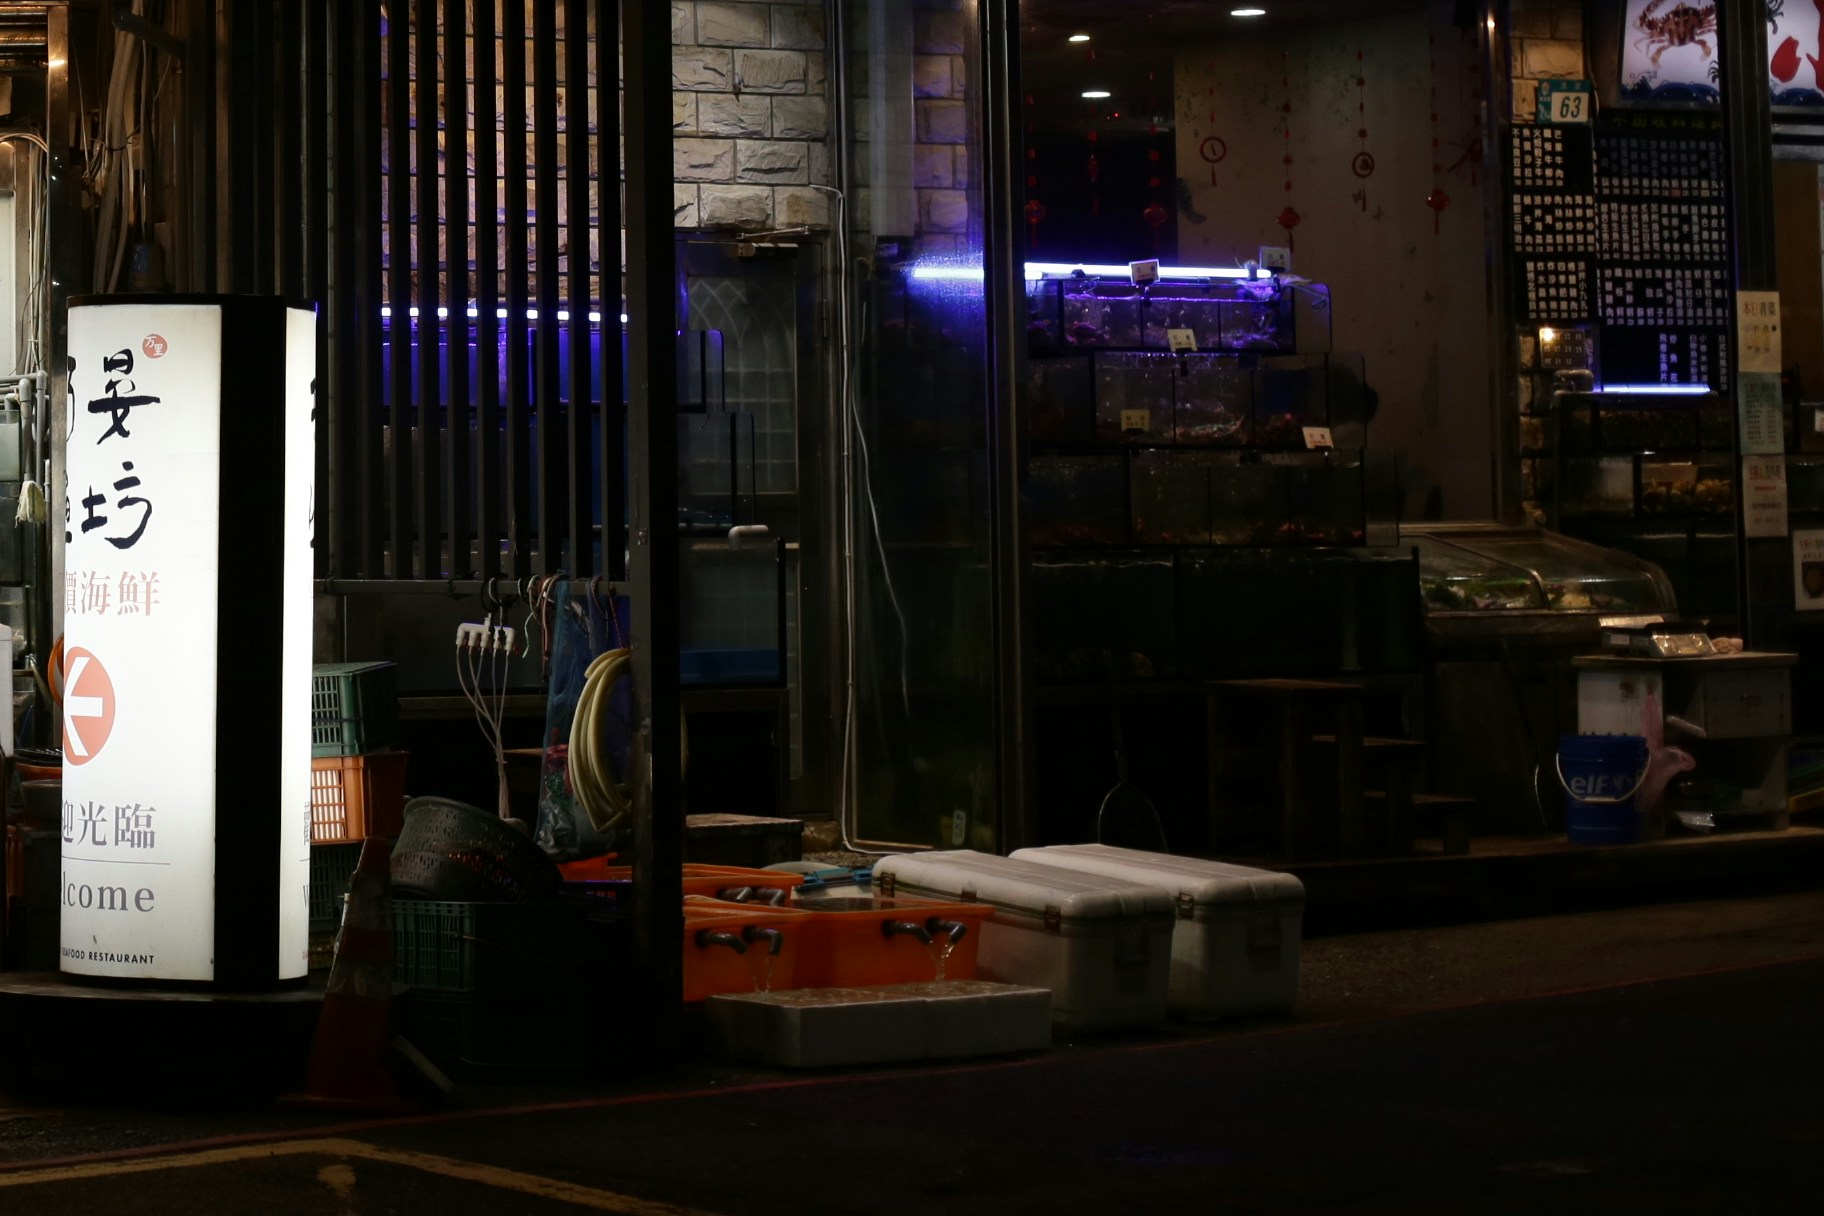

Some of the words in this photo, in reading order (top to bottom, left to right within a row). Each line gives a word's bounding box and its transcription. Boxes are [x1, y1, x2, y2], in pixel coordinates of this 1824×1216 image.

[1559, 95, 1582, 119] 63
[142, 333, 168, 359] 万里
[1570, 774, 1610, 795] elf
[88, 951, 155, 965] RESTAURANT
